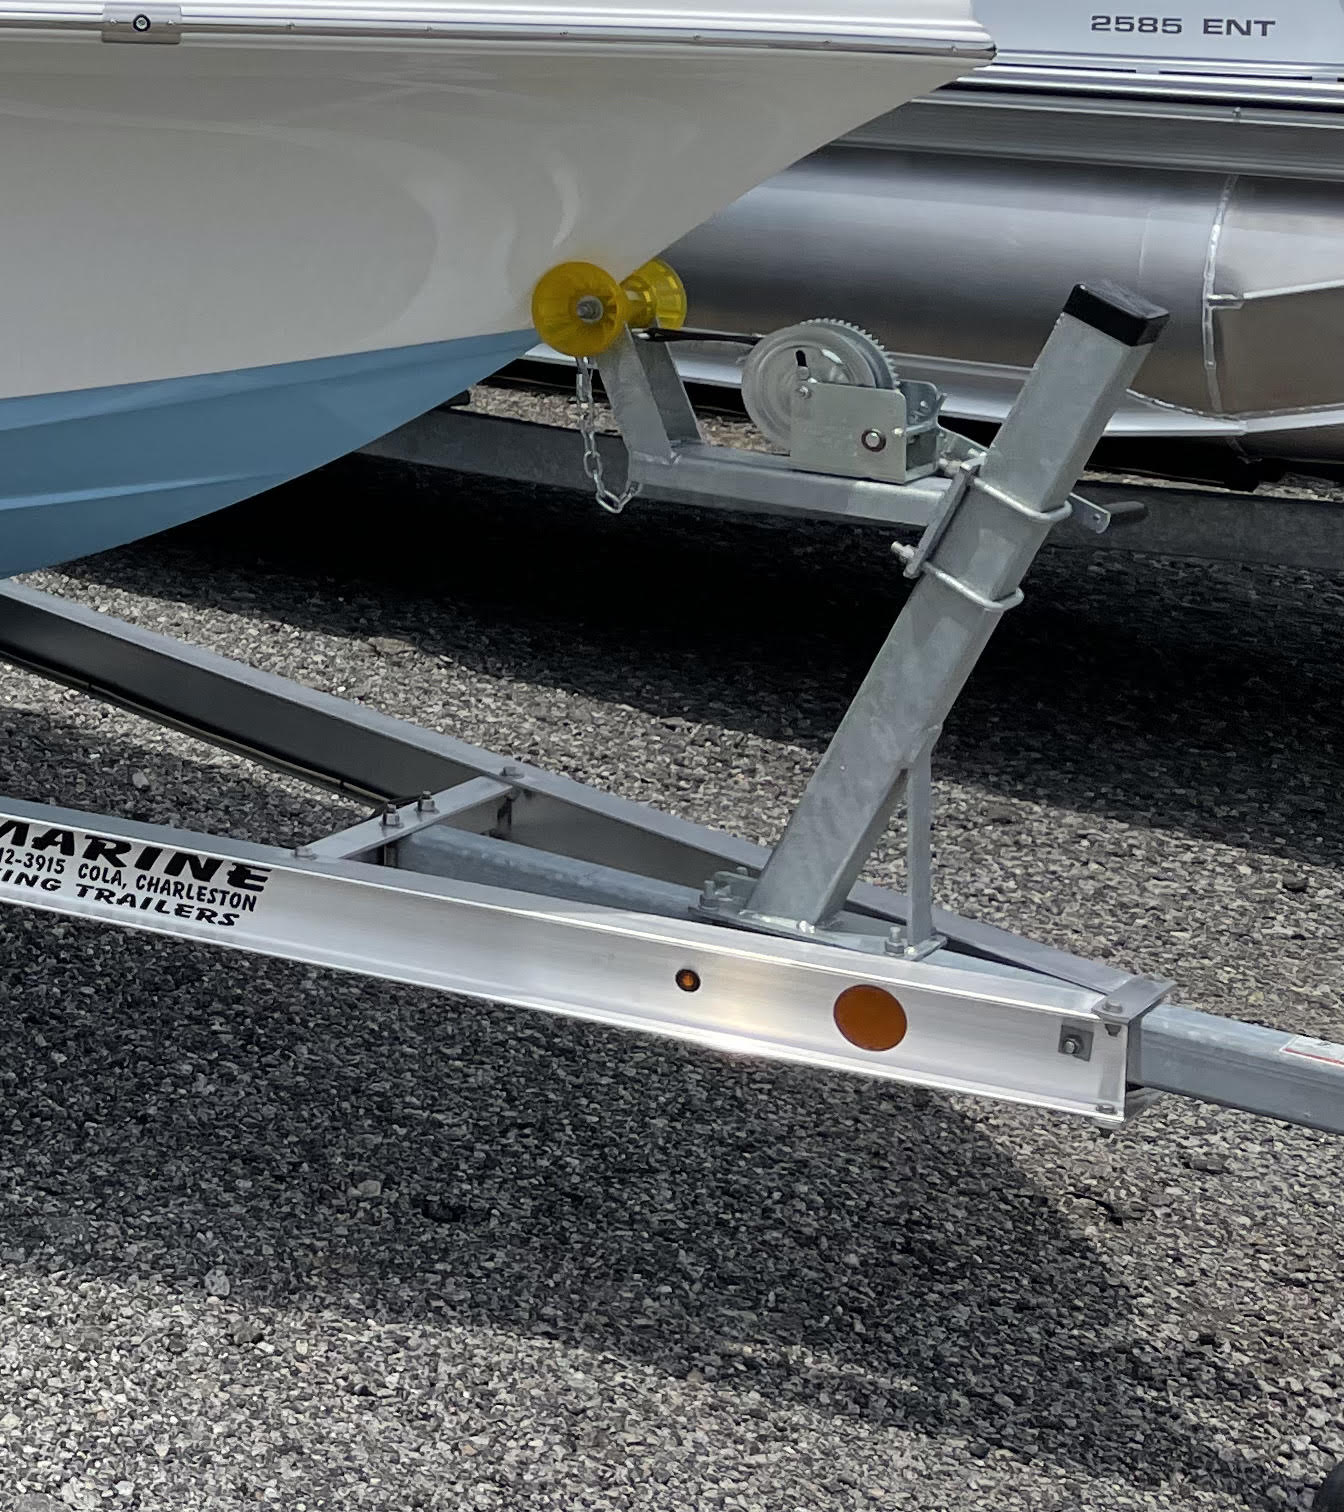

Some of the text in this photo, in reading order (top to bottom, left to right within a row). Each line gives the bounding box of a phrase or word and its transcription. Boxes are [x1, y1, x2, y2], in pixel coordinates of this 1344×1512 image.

[1091, 15, 1276, 37] 2585 ENT
[76, 883, 240, 926] TRAILERS
[78, 863, 128, 889] COLA,
[136, 874, 257, 912] CHARLESTON
